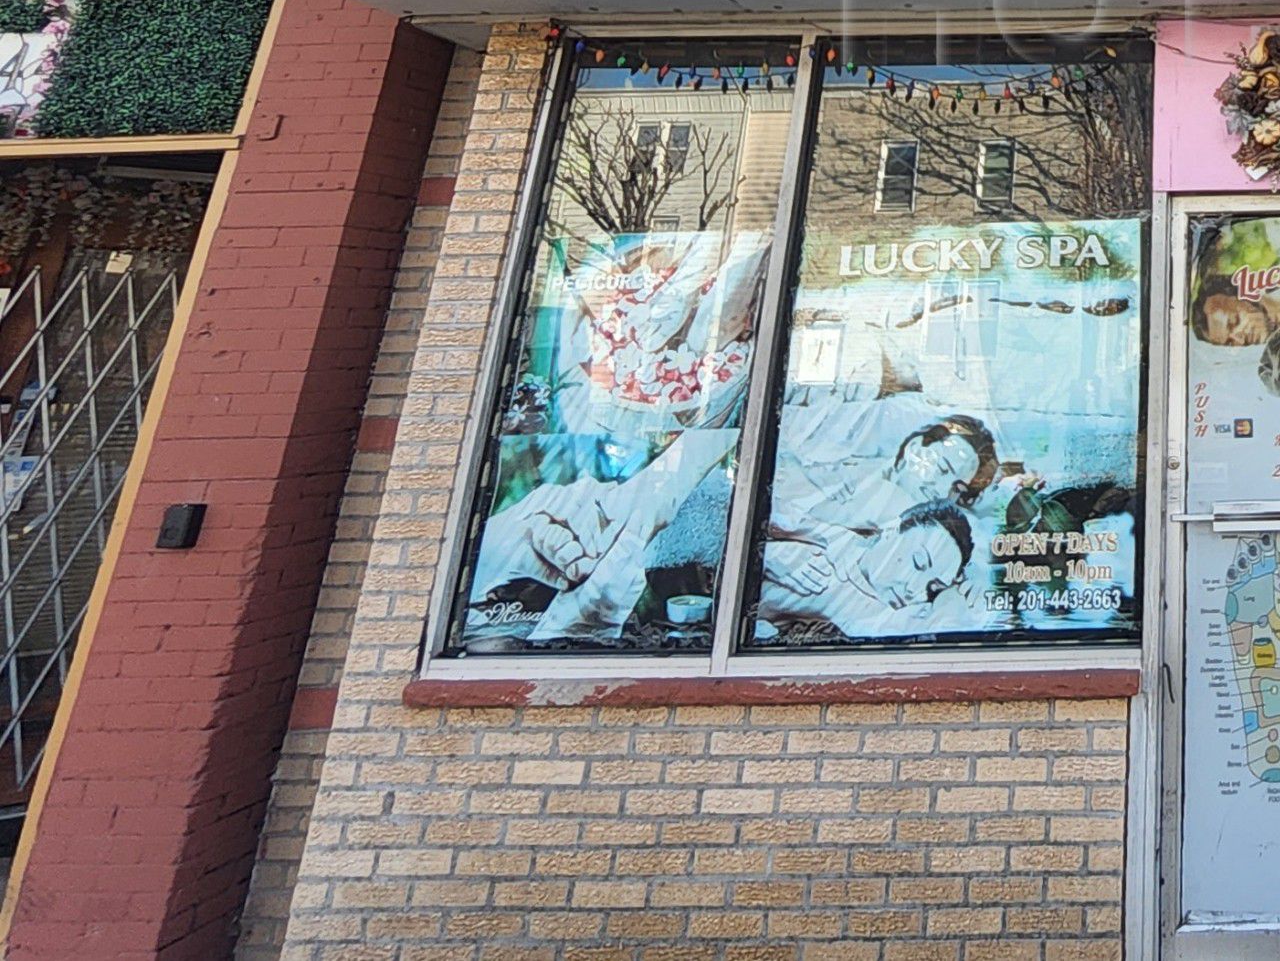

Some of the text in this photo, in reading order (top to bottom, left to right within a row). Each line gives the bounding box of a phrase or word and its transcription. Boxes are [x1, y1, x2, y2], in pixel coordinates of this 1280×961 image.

[838, 233, 1111, 277] LUCKY SPA
[991, 530, 1119, 557] OPEN 7 DAYS
[1003, 560, 1051, 583] 10am
[1065, 559, 1112, 585] 10pm
[984, 589, 1122, 611] Tel: 201-443-2663
